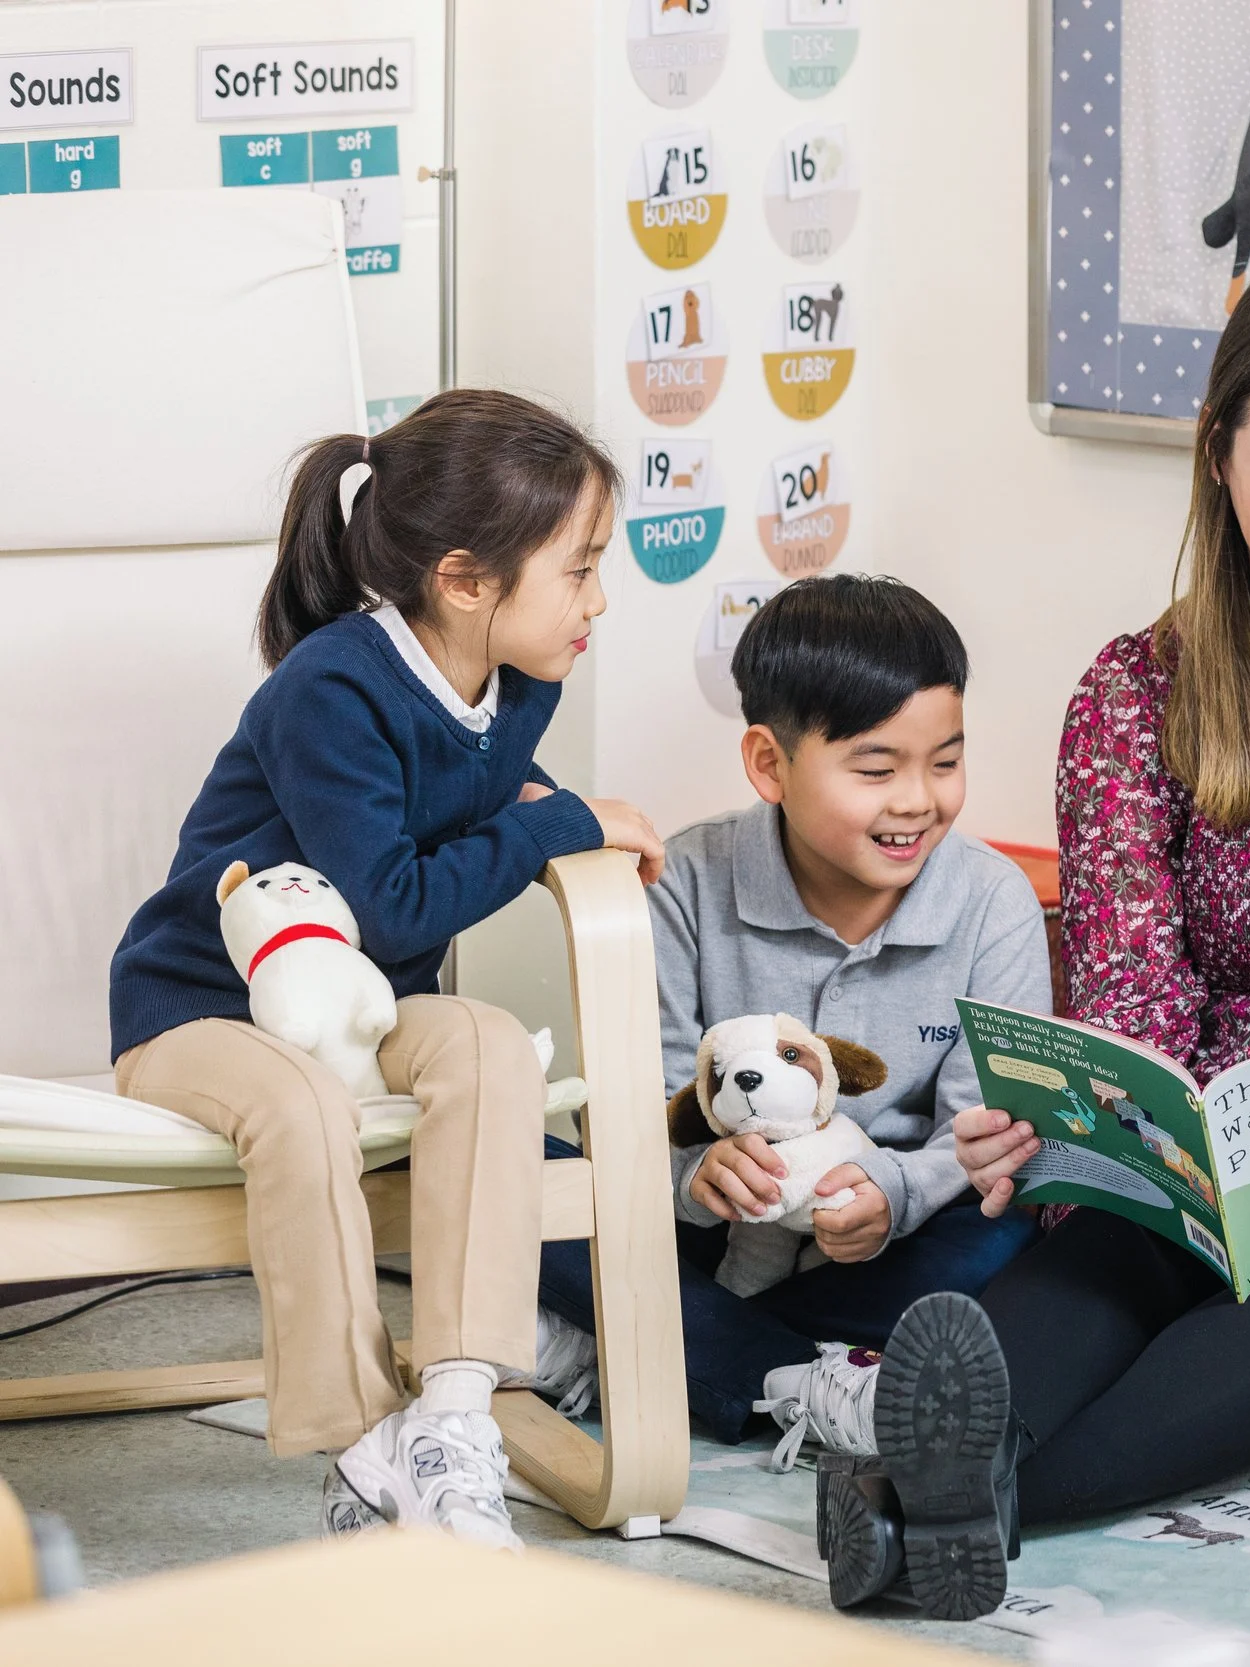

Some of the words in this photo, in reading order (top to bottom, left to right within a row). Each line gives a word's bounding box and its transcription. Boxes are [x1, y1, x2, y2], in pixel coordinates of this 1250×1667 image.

[792, 34, 836, 60] DESK
[9, 67, 120, 108] Sounds
[215, 62, 281, 99] Soft
[294, 57, 399, 94] Sounds
[55, 140, 95, 162] hard
[247, 136, 282, 157] soft
[337, 130, 371, 152] soft
[260, 164, 271, 180] c
[350, 157, 362, 178] g
[684, 147, 708, 184] 15
[791, 143, 816, 182] 16
[70, 169, 81, 189] g
[643, 197, 710, 228] BOARD
[650, 305, 672, 344] 17
[789, 295, 814, 332] 18
[646, 360, 707, 388] PENCIL
[781, 356, 837, 384] CUBBY
[647, 452, 670, 488] 19
[782, 465, 817, 509] 20
[643, 515, 706, 551] PHOTO
[968, 1007, 987, 1019] The
[918, 1025, 957, 1043] YISS
[973, 1021, 1010, 1036] REALLY
[1012, 1030, 1042, 1044] wants
[1045, 1038, 1051, 1047] a
[1015, 1041, 1041, 1055] think
[1060, 1054, 1067, 1063] a
[1069, 1057, 1091, 1071] good
